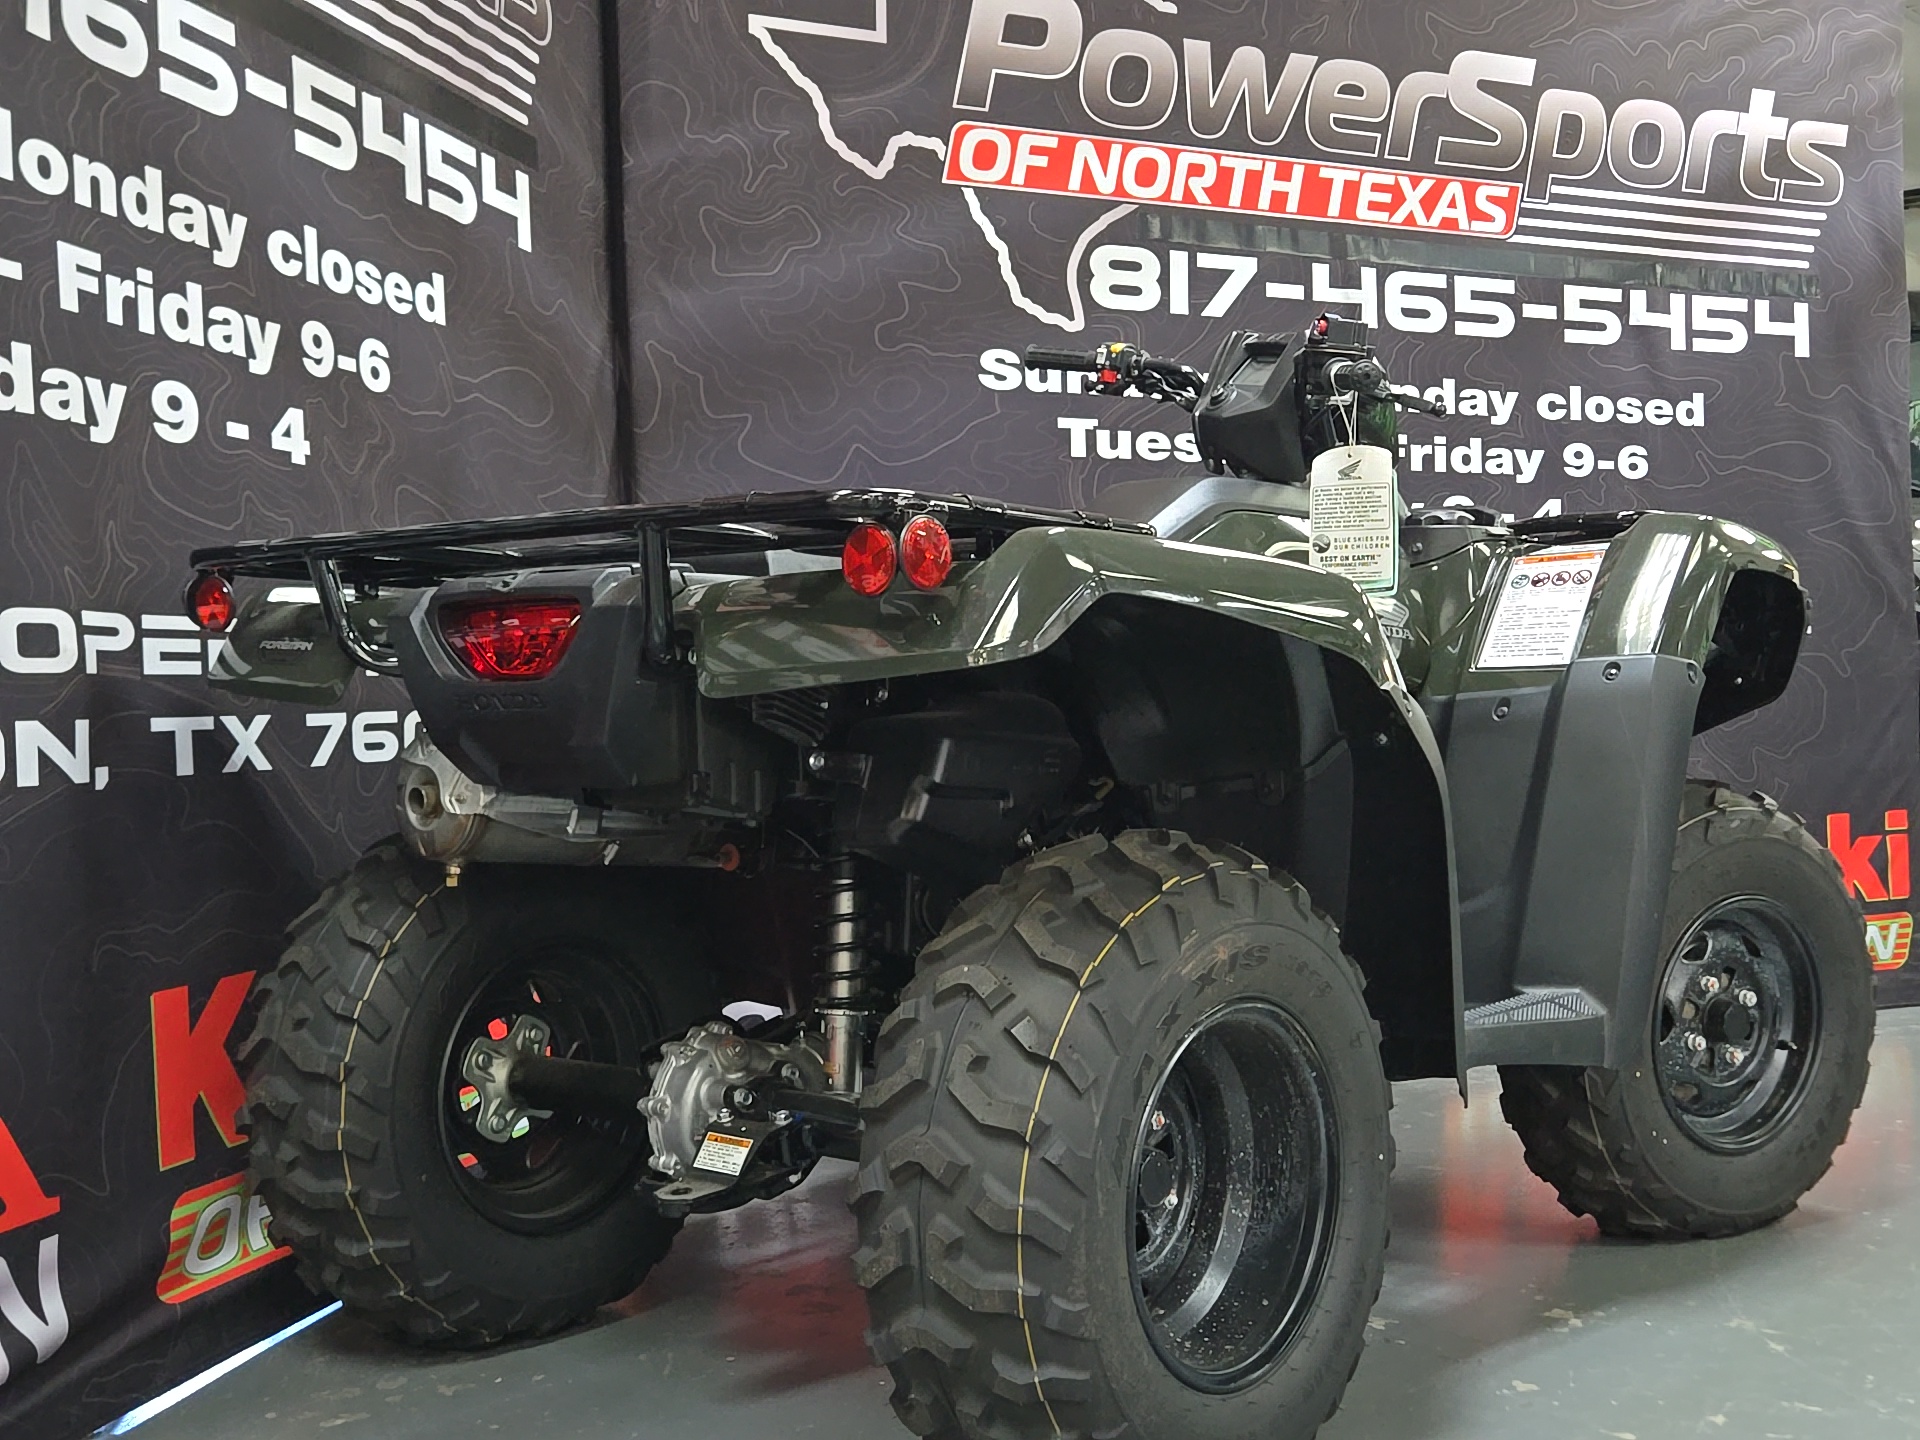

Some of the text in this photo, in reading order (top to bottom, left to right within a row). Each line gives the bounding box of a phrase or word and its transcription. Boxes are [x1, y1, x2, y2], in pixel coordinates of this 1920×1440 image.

[953, 0, 1849, 206] PowerSports
[959, 128, 1510, 234] OF NORTH TEXAS
[57, 240, 280, 375] Friday
[301, 320, 391, 393] 9-6
[267, 224, 446, 326] closed
[1089, 244, 1810, 358] 817-465-5454
[151, 380, 199, 444] 9
[271, 407, 310, 465] 4
[1057, 417, 1202, 463] Tues
[1562, 442, 1649, 480] 9-6
[1536, 385, 1705, 427] closed
[150, 715, 272, 776] TX
